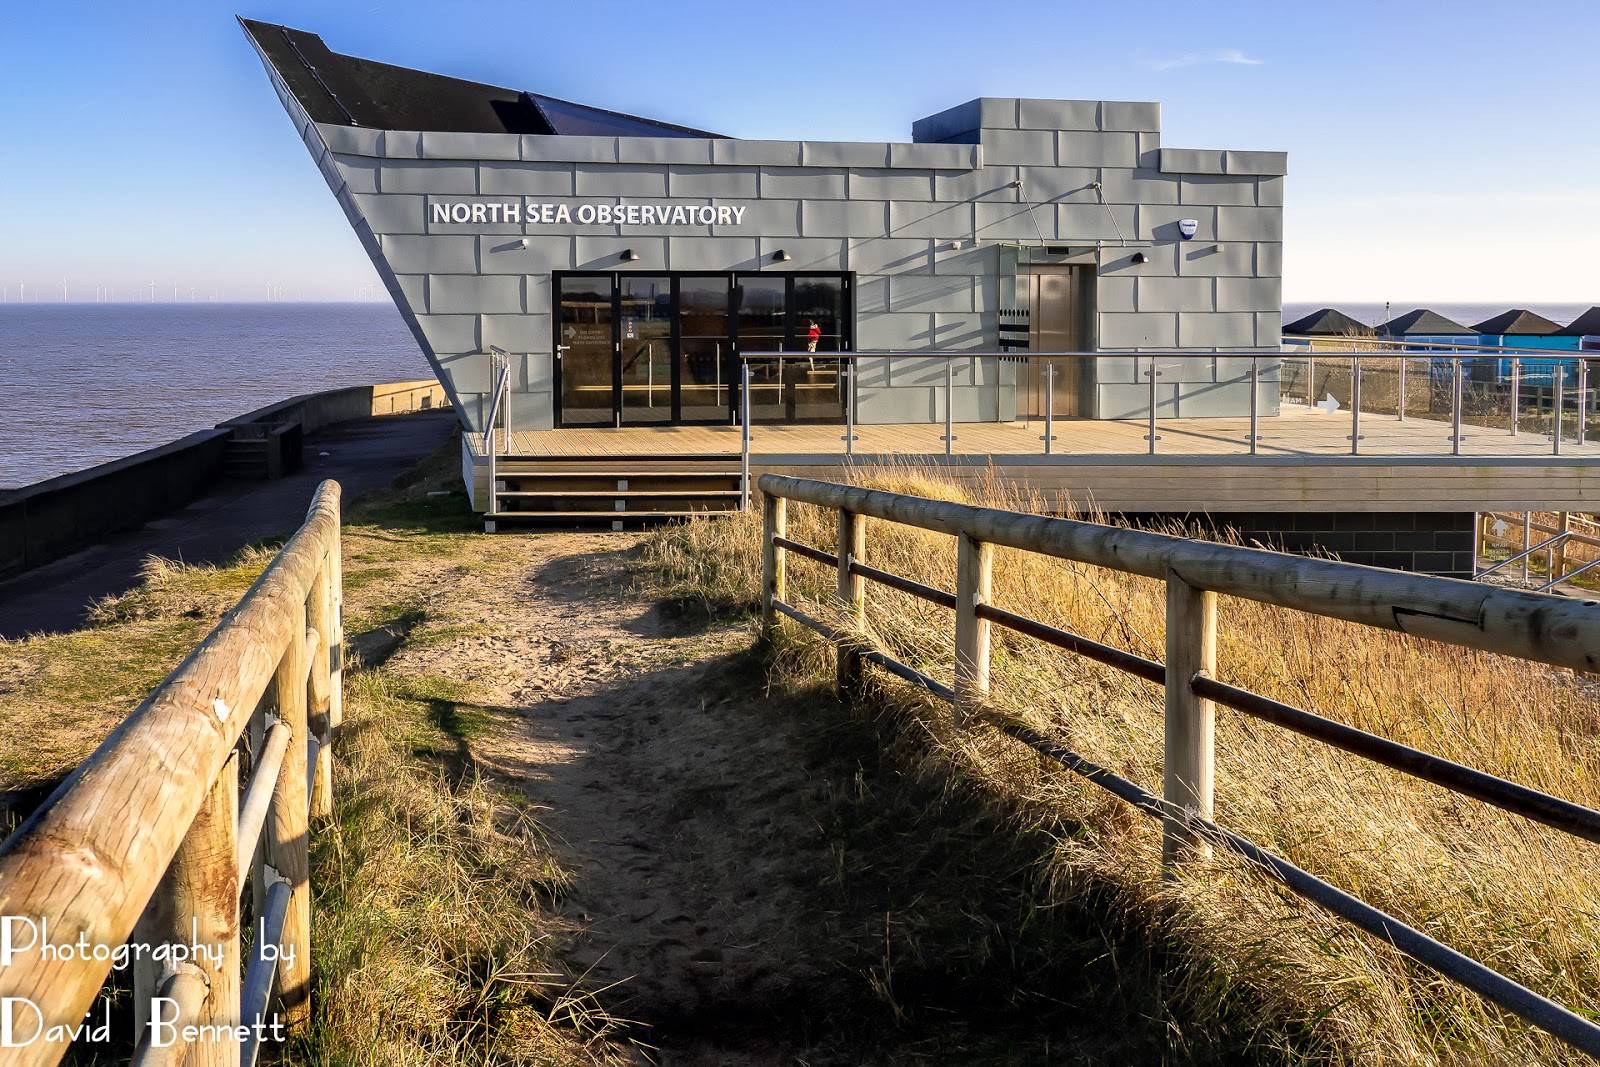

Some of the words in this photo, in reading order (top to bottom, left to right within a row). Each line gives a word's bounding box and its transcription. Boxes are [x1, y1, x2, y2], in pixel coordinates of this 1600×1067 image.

[434, 203, 519, 222] NORTH
[526, 203, 571, 223] SEA
[578, 205, 746, 225] OBSERVATORY
